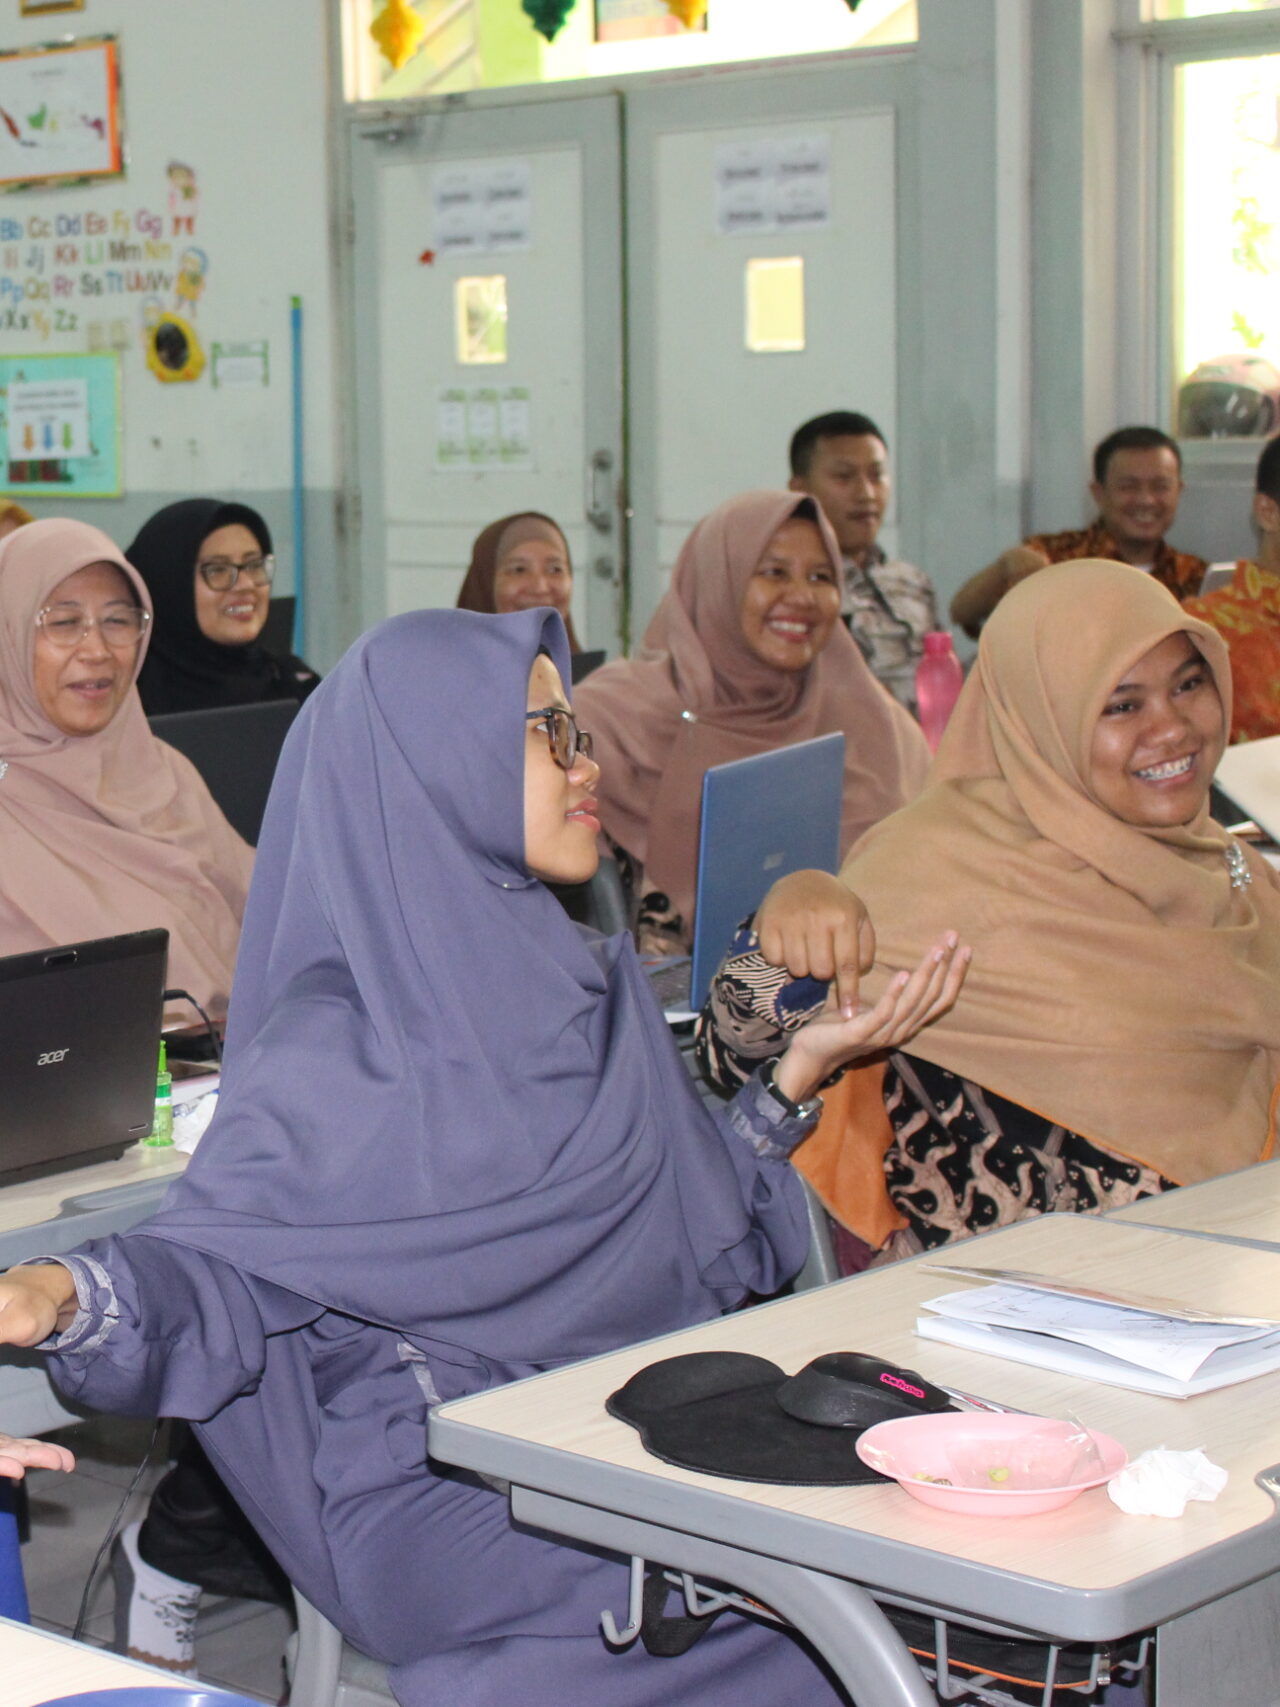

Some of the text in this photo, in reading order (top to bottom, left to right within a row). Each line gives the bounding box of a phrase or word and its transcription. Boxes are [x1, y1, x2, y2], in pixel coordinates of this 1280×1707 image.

[0, 218, 22, 241] Bb
[28, 217, 50, 238] Cc
[55, 214, 81, 237] Dd
[85, 212, 107, 235] Ee
[136, 210, 162, 239] Gg
[26, 246, 44, 274] Jj
[54, 244, 78, 265] Kk
[0, 276, 24, 304] Pp
[25, 276, 50, 304] Qq
[54, 274, 73, 296] Rr
[80, 272, 103, 295] Ss
[105, 270, 123, 293] Tt
[54, 308, 79, 331] Zz
[37, 1048, 70, 1066] acer
